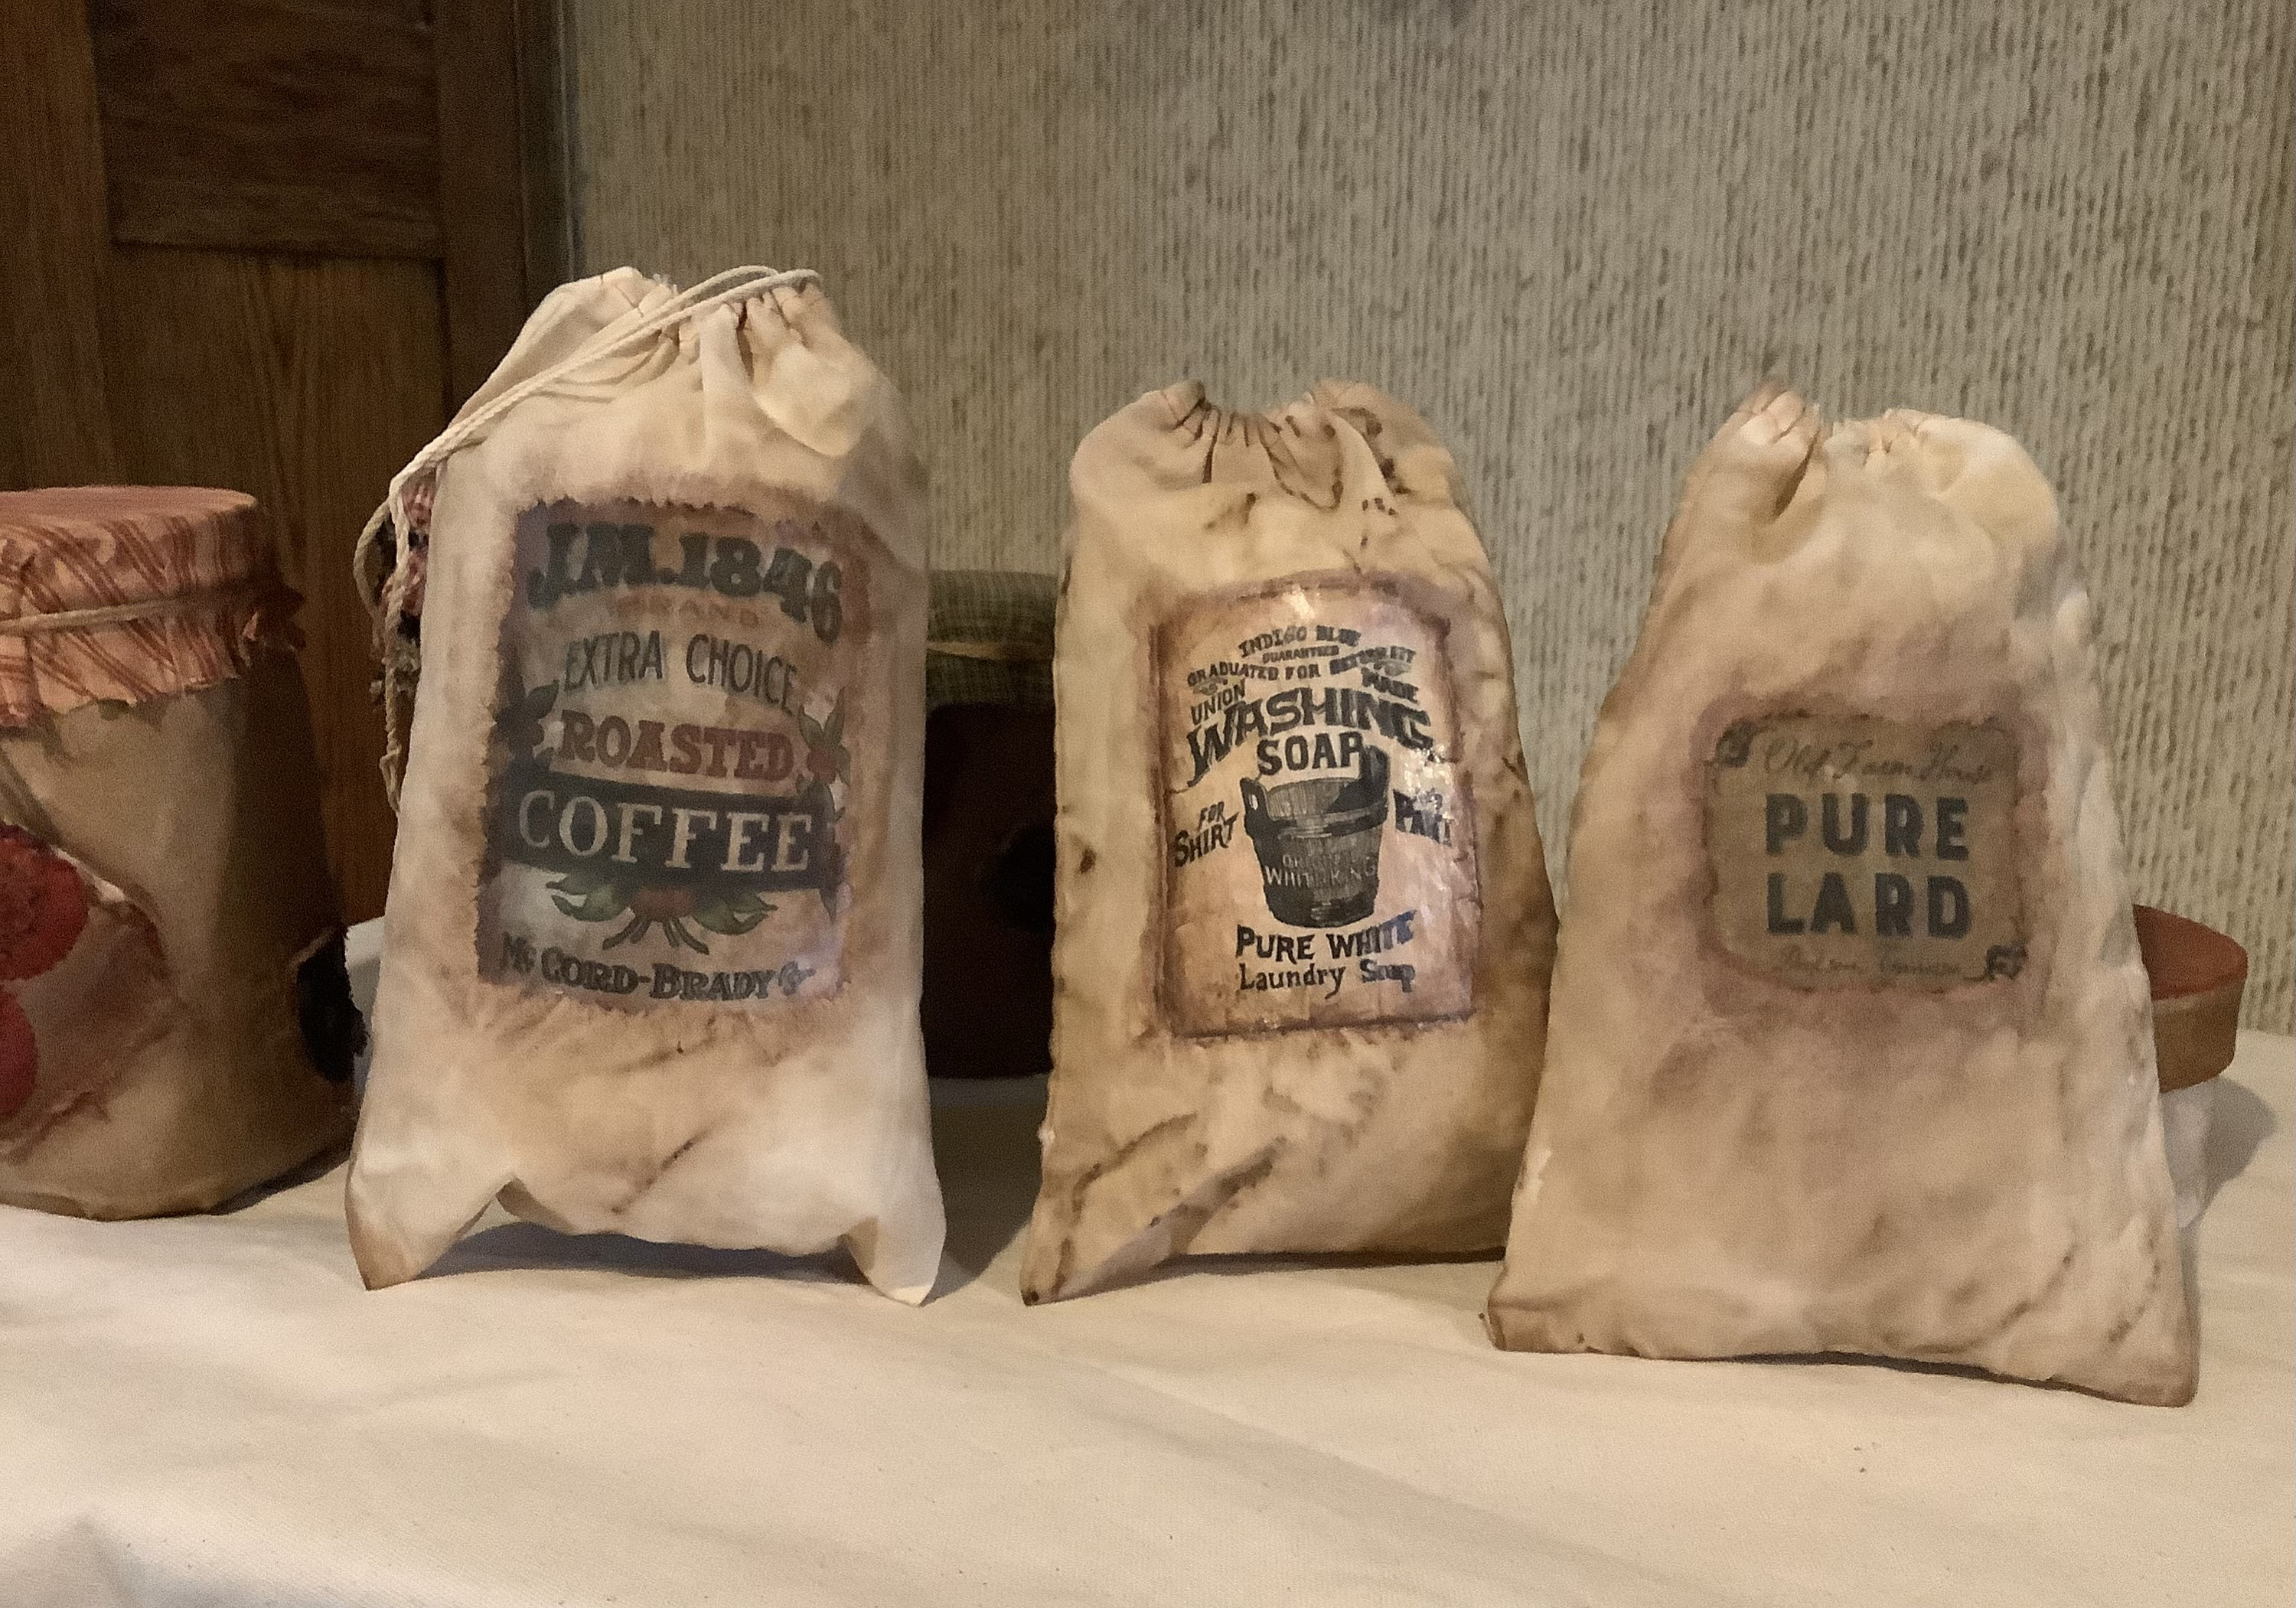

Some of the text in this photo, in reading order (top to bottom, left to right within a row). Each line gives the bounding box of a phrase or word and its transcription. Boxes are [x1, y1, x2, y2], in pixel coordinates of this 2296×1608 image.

[1238, 625, 1307, 658] INDIGO
[564, 630, 798, 716] EXTRA CHOICE
[1187, 660, 1321, 688] GRADUATED FOR
[1191, 679, 1246, 726] UNION
[559, 709, 795, 783] ROASTED
[1186, 687, 1433, 788] WASHING
[1257, 732, 1365, 776] SOAP
[519, 788, 812, 872] COFFEE
[1174, 812, 1239, 868] SHIRT
[1199, 801, 1225, 826] FOR
[1766, 792, 1969, 860] PURE
[1766, 872, 1971, 939] LARD
[1235, 909, 1417, 965] PURE WHITE
[1239, 963, 1347, 1000] Laundry
